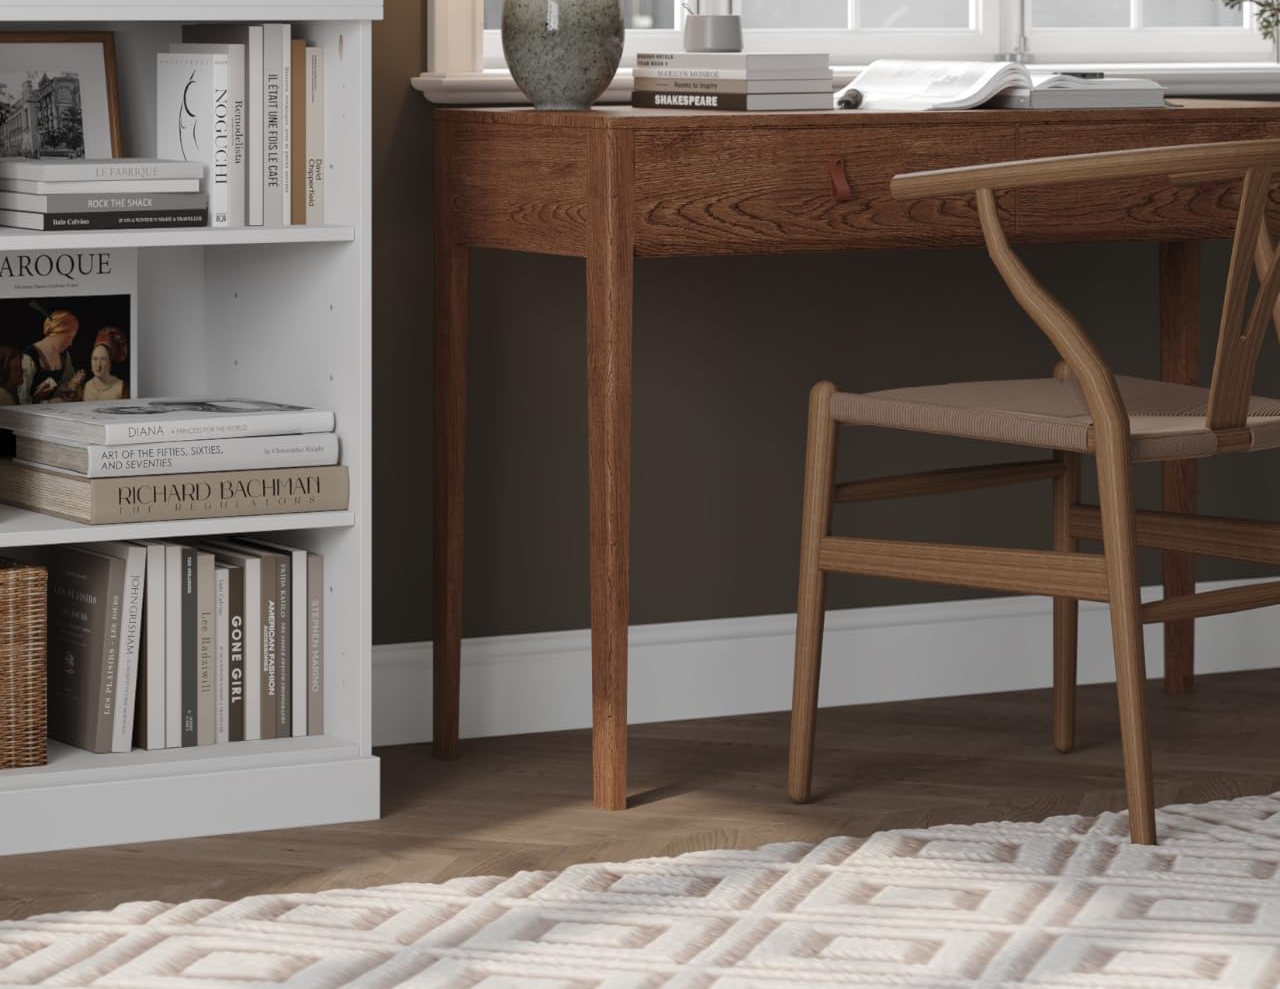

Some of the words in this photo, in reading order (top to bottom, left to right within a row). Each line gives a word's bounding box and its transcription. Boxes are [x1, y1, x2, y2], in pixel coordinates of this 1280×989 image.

[269, 74, 278, 82] IL
[269, 85, 280, 108] ÉTAIT
[655, 95, 718, 107] SHAKESPEARE
[269, 111, 278, 128] UNE
[214, 89, 227, 184] NOGUCHI
[234, 100, 244, 164] Remodelista
[269, 131, 278, 150] FOIS
[269, 153, 278, 162] LE
[269, 165, 280, 187] CAFÉ
[308, 158, 316, 207] Chipperfield
[88, 199, 109, 208] ROCK
[111, 198, 126, 208] THE
[128, 197, 152, 207] SHACK
[128, 426, 164, 437] DIANA
[101, 451, 118, 460] ART
[121, 450, 135, 459] OF
[138, 449, 154, 458] THE
[157, 447, 188, 457] FIFTIES,
[190, 445, 224, 456] SIXTIES,
[101, 461, 122, 470] AND
[125, 458, 172, 468] SEVENTIES
[118, 482, 211, 505] RICHARD
[220, 475, 320, 500] BACHMAN
[129, 575, 140, 605] JOHN
[126, 605, 139, 654] GRISHAM
[201, 612, 211, 631] Lee
[311, 600, 320, 648] STEPHEN
[231, 615, 242, 662] GONE
[201, 637, 211, 694] Radziwill
[311, 651, 320, 692] MARINO
[231, 668, 242, 704] GIRL
